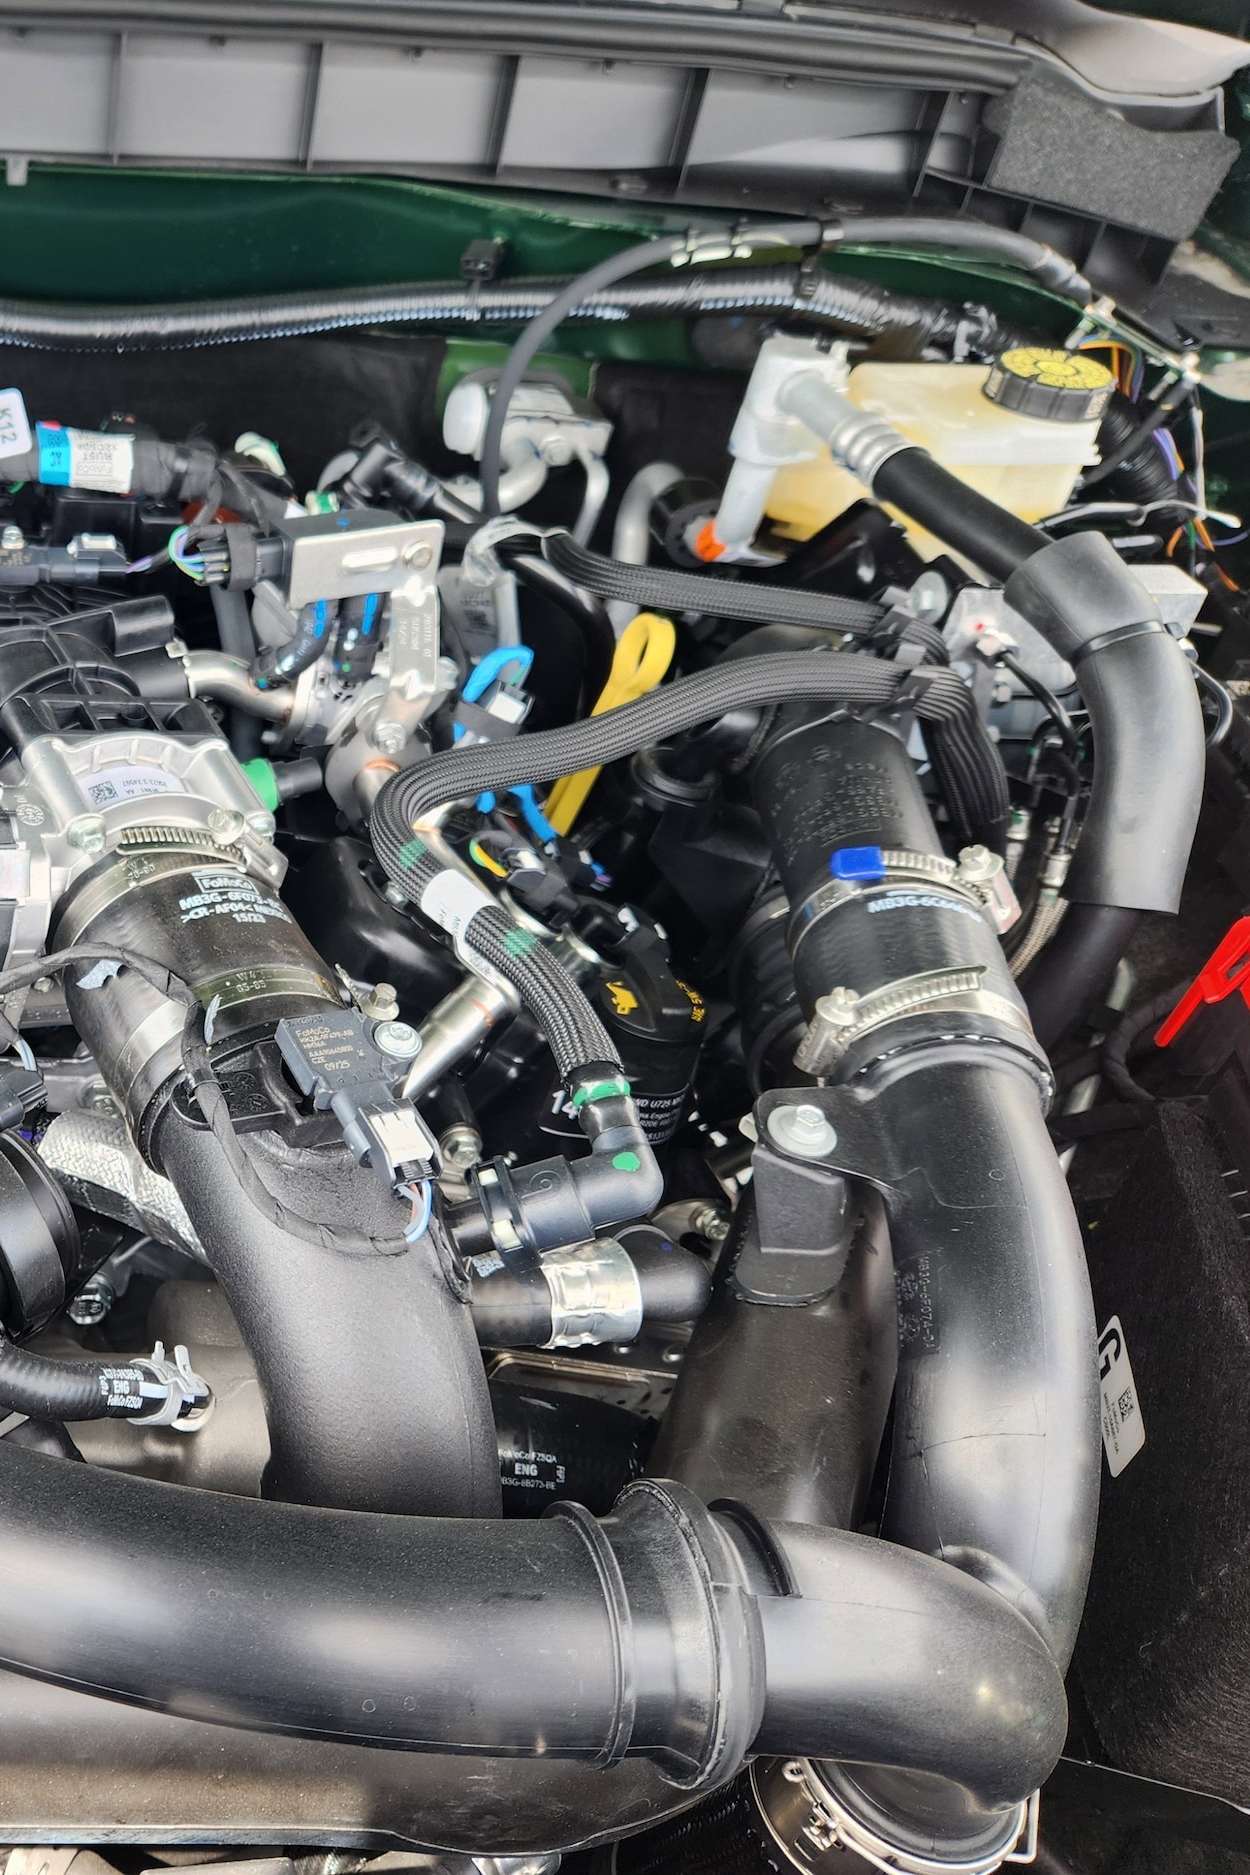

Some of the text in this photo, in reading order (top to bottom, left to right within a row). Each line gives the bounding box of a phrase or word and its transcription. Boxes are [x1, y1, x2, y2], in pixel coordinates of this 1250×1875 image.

[201, 877, 252, 890] FoMoCo
[295, 1026, 330, 1038] FoMoCo
[1098, 1328, 1121, 1381] G
[113, 1380, 130, 1394] ENG
[514, 1462, 538, 1477] ENG
[501, 1476, 556, 1490] B3G-8B273-BE
